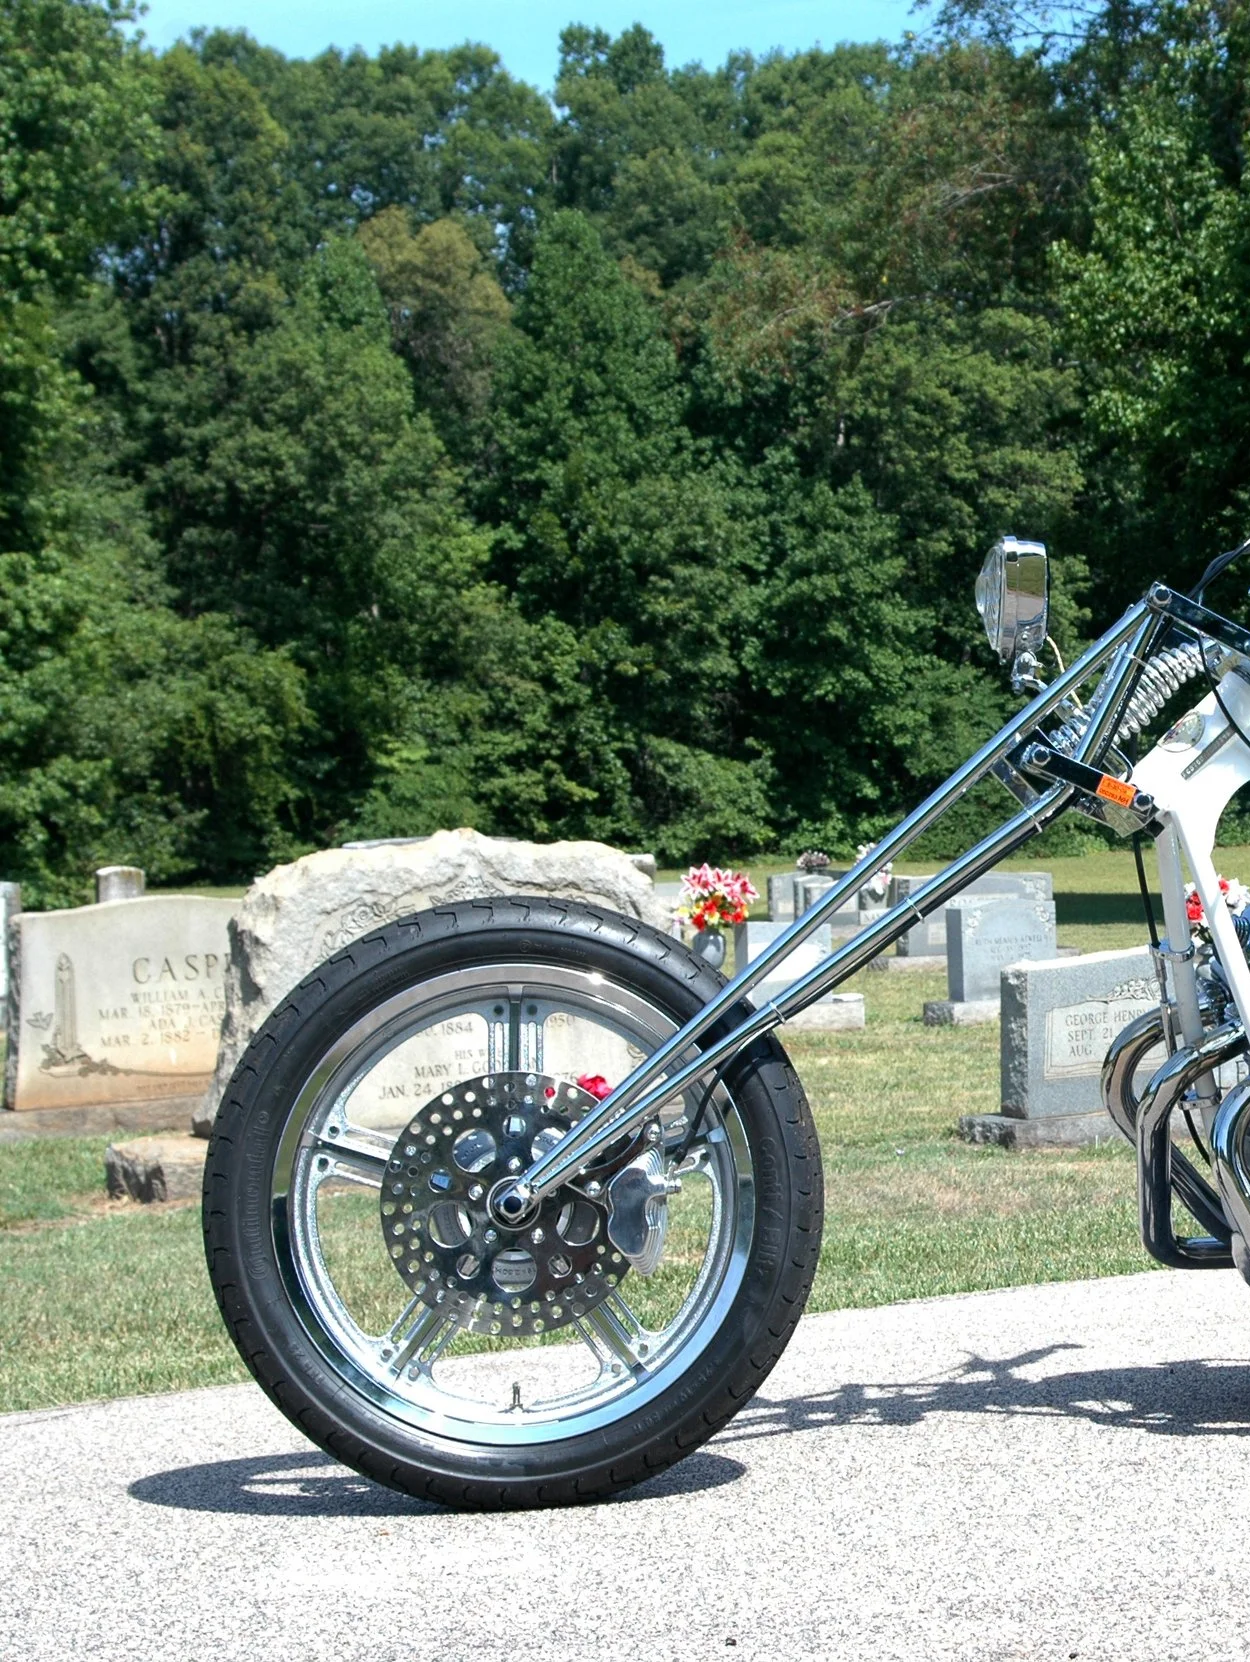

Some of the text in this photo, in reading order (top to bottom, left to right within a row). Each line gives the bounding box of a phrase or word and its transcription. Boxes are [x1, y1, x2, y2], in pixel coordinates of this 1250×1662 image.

[133, 953, 231, 984] CASP
[130, 989, 189, 1004] WILLIAM
[150, 1017, 176, 1030] ADA
[1065, 1011, 1109, 1027] GEORGE
[441, 1021, 474, 1036] 1884
[455, 1050, 473, 1060] HIS
[414, 1064, 451, 1078] MARY
